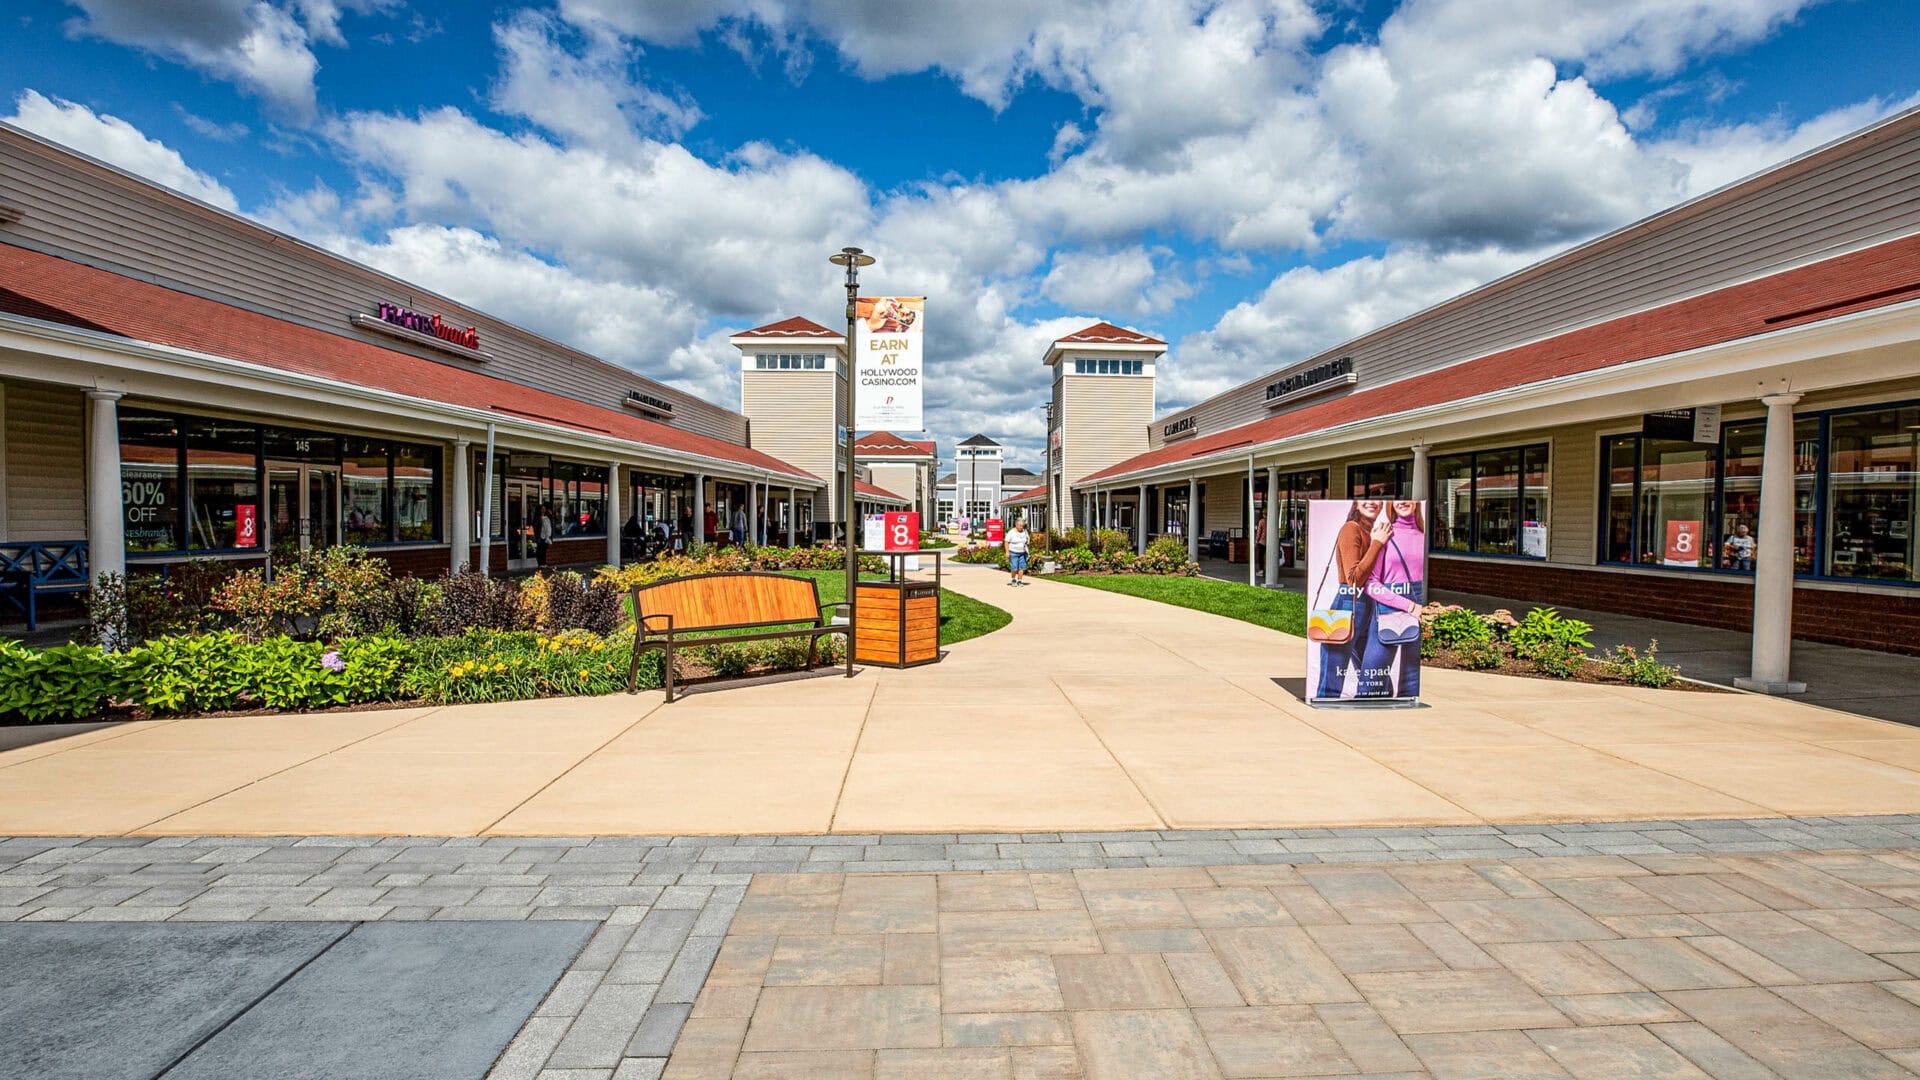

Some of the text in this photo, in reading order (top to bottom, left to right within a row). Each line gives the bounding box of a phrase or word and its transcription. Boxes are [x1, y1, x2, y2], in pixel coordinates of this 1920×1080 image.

[870, 339, 909, 351] EARN
[881, 353, 898, 365] AT
[860, 368, 918, 377] HOLLYWOOD
[861, 378, 917, 386] CASINO.COM
[295, 440, 310, 452] 145
[128, 507, 157, 522] OFF
[1368, 582, 1385, 595] for
[1391, 582, 1411, 595] fall
[1363, 665, 1393, 679] spad
